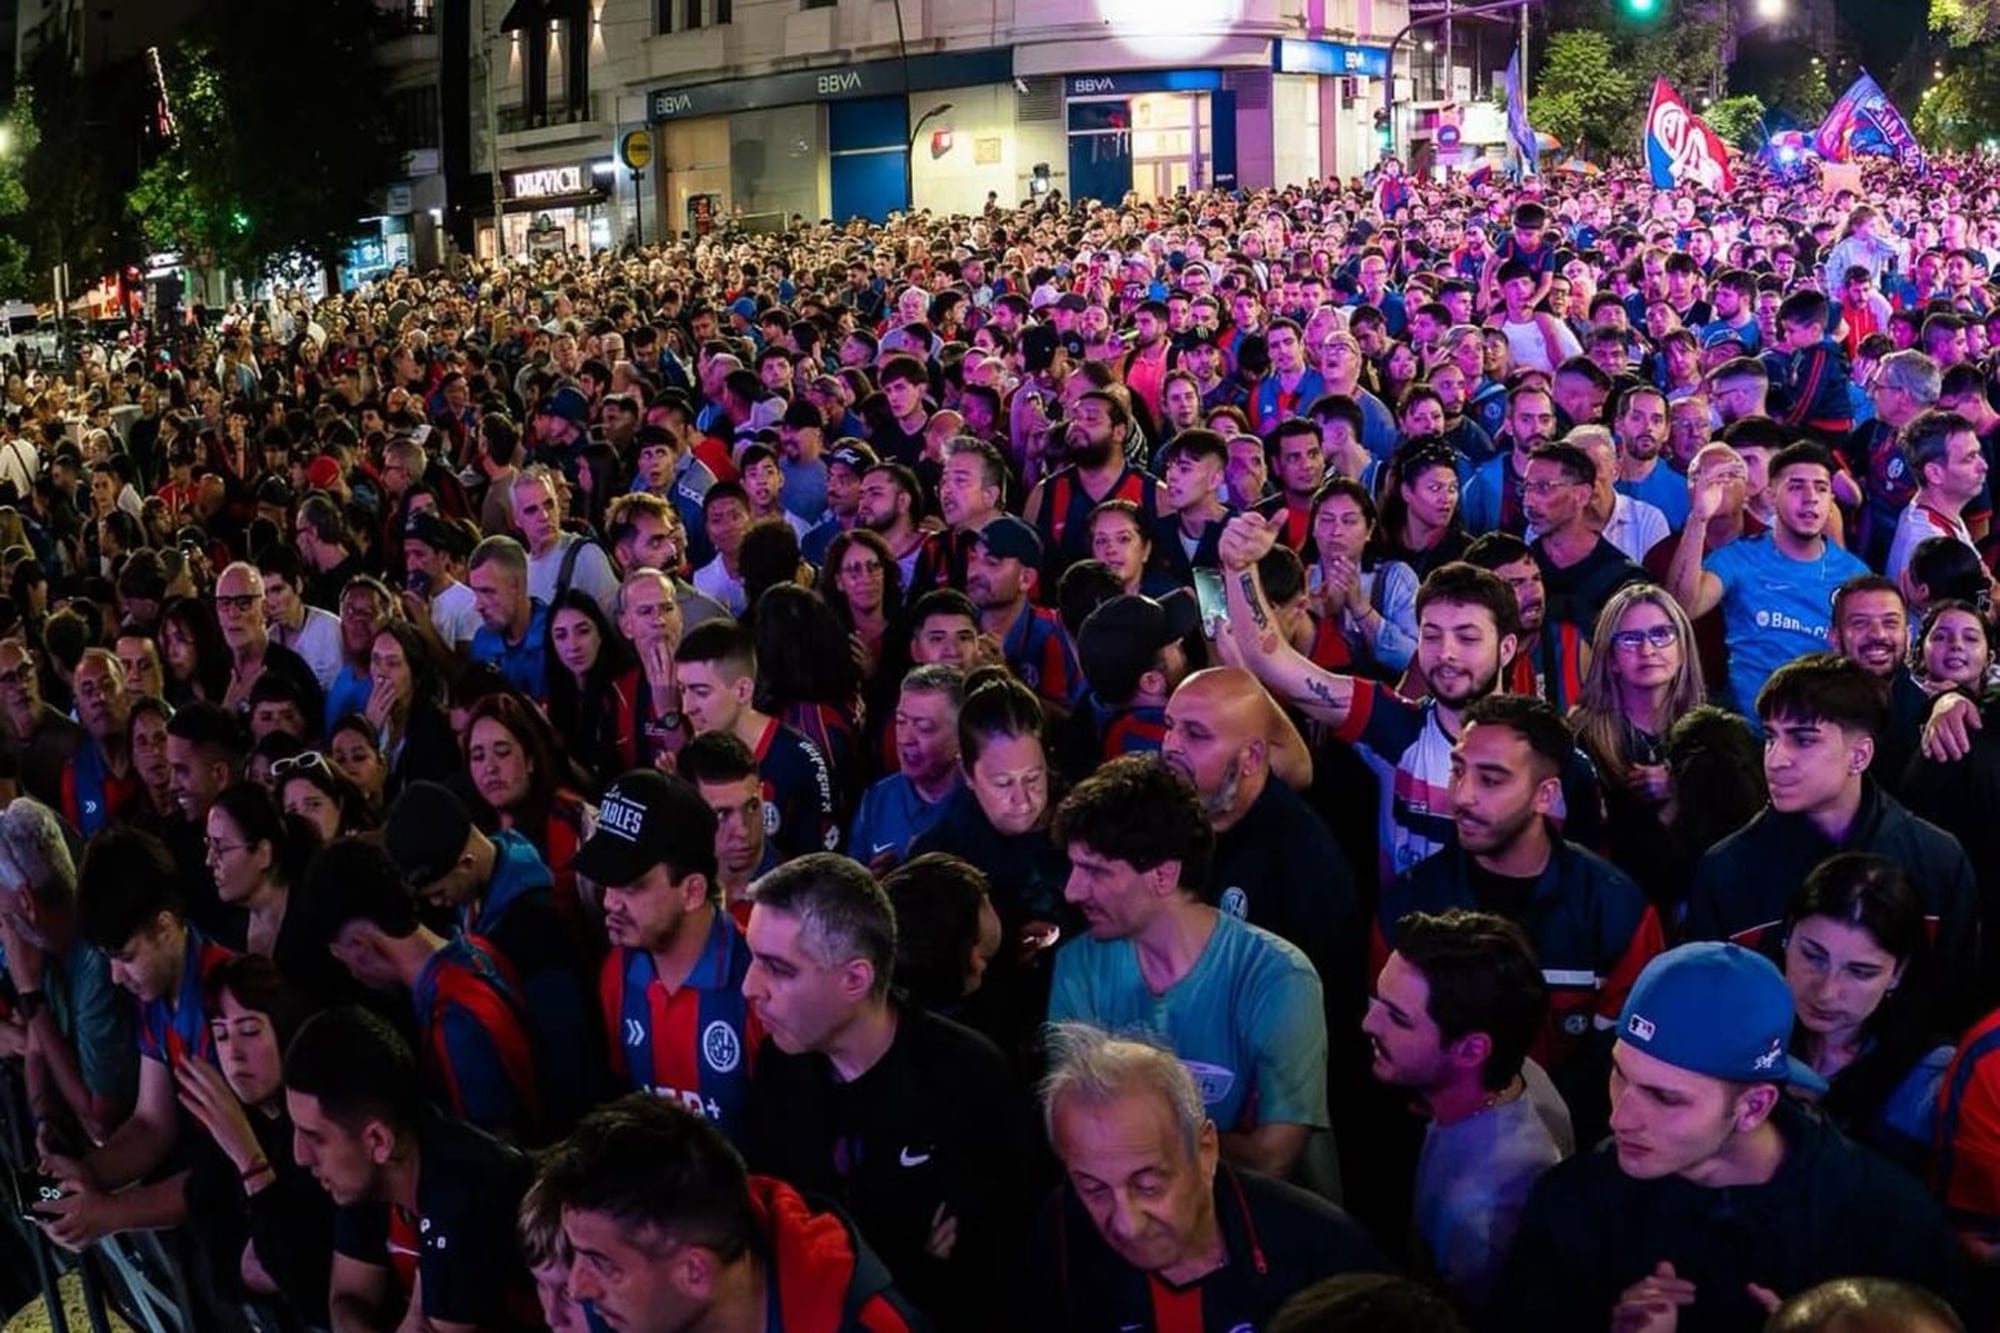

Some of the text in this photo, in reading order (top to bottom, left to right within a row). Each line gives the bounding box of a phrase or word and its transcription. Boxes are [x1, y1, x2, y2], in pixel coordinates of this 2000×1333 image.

[818, 72, 861, 94] BBVA
[1075, 77, 1115, 92] BBVA
[656, 94, 692, 114] BBVA
